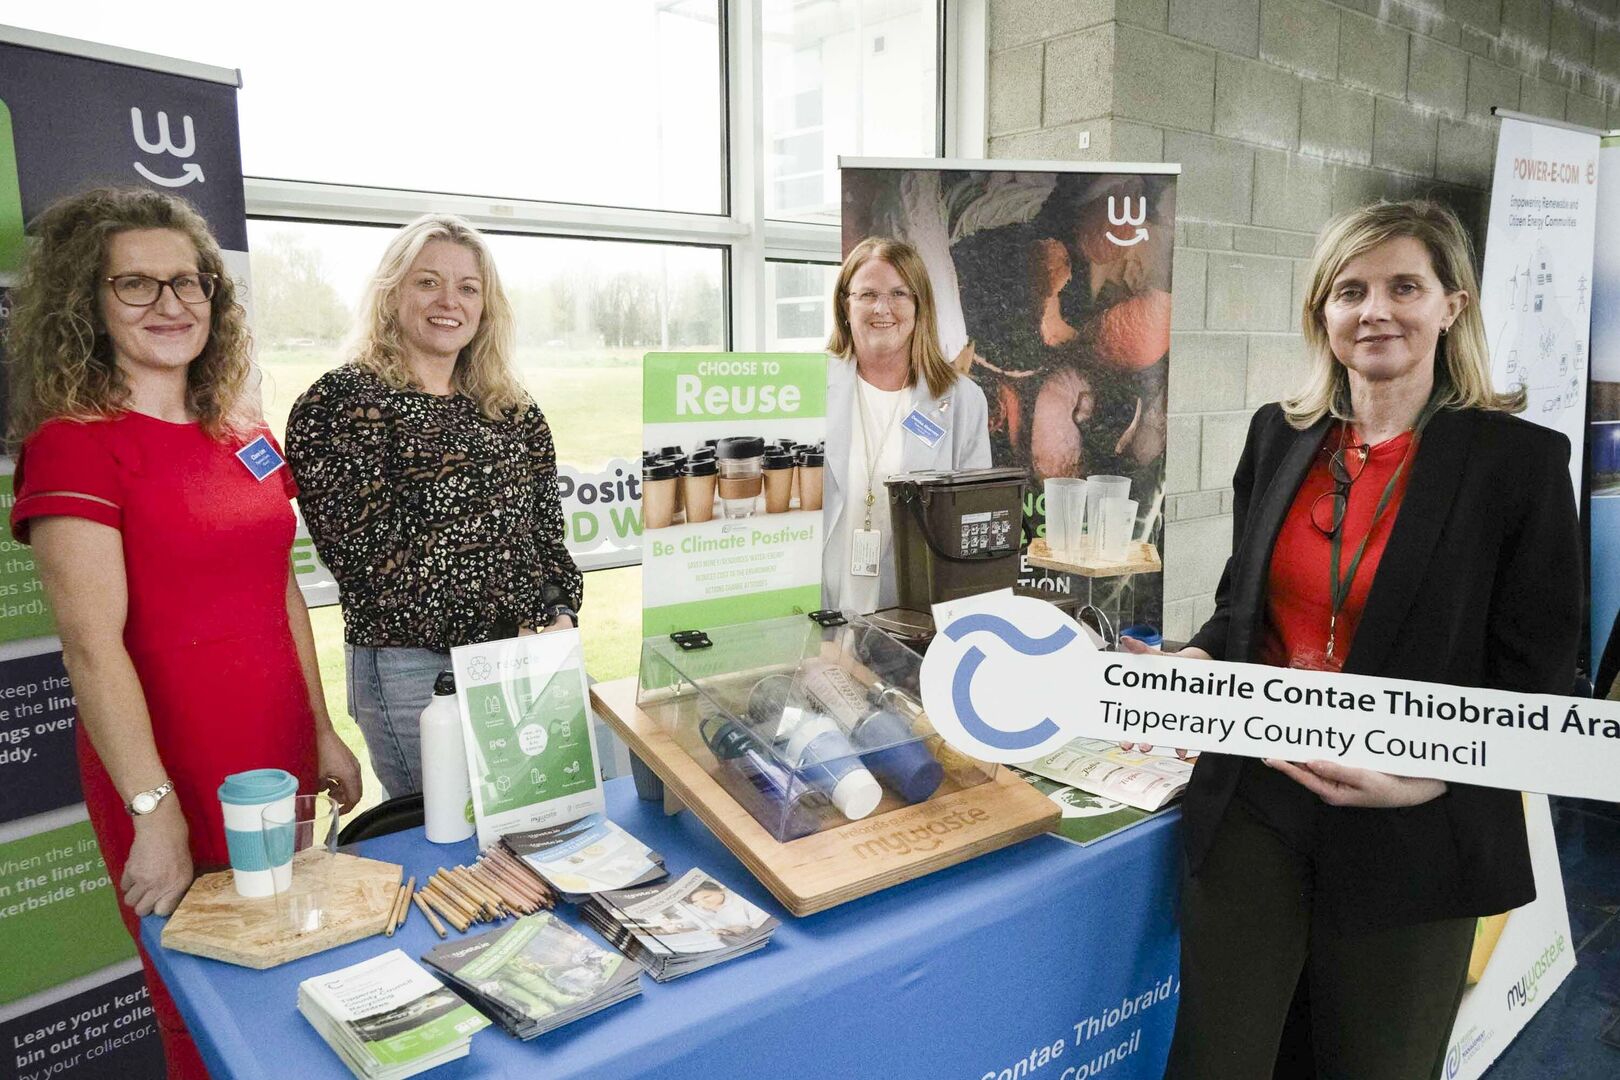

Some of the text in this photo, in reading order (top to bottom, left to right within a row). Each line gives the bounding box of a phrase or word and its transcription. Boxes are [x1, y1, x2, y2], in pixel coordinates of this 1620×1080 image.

[698, 361, 781, 376] CHOOSE TO
[675, 373, 801, 416] Reuse
[652, 540, 675, 557] Be
[680, 535, 746, 554] Climate
[751, 525, 815, 546] Postive!
[42, 675, 71, 691] the
[1103, 663, 1620, 740] Comhairle Contae Thiobraid Ára
[14, 703, 44, 718] the
[35, 716, 76, 735] over
[1099, 700, 1487, 767] Tipperary County Council
[44, 846, 74, 862] the
[852, 806, 991, 860] mywaste
[15, 874, 48, 893] the
[51, 860, 93, 881] liner
[1506, 930, 1565, 1012] mywaste.ie
[14, 1019, 67, 1050] Leave
[70, 1001, 111, 1030] your
[1073, 974, 1173, 1047] Thiobraid
[16, 1048, 46, 1069] bin
[50, 1034, 82, 1055] out
[84, 1021, 110, 1042] for
[43, 1054, 82, 1080] your
[86, 1023, 157, 1060] collector.
